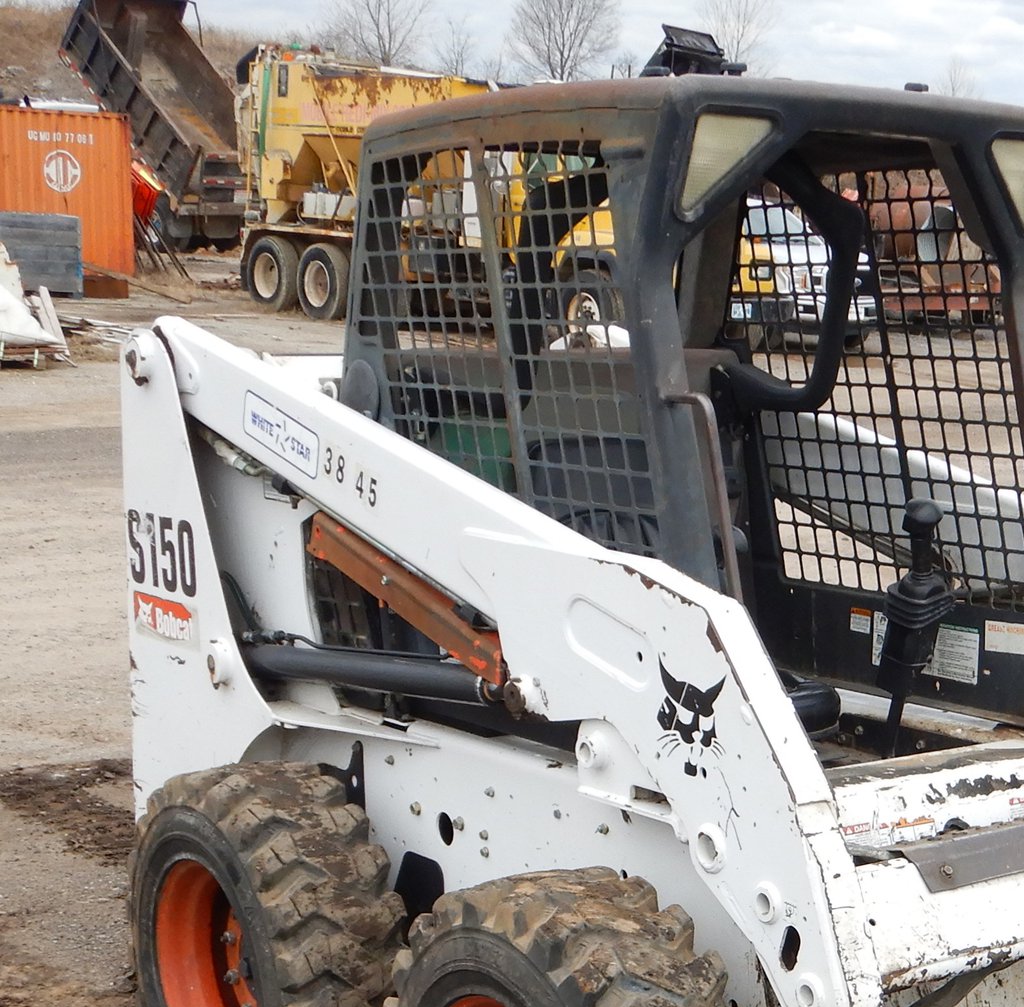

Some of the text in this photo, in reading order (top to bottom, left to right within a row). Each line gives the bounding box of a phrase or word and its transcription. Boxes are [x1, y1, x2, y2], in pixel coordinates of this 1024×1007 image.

[251, 410, 311, 462] WHITE STAR
[127, 509, 197, 597] S150
[155, 606, 193, 640] Bobcat
